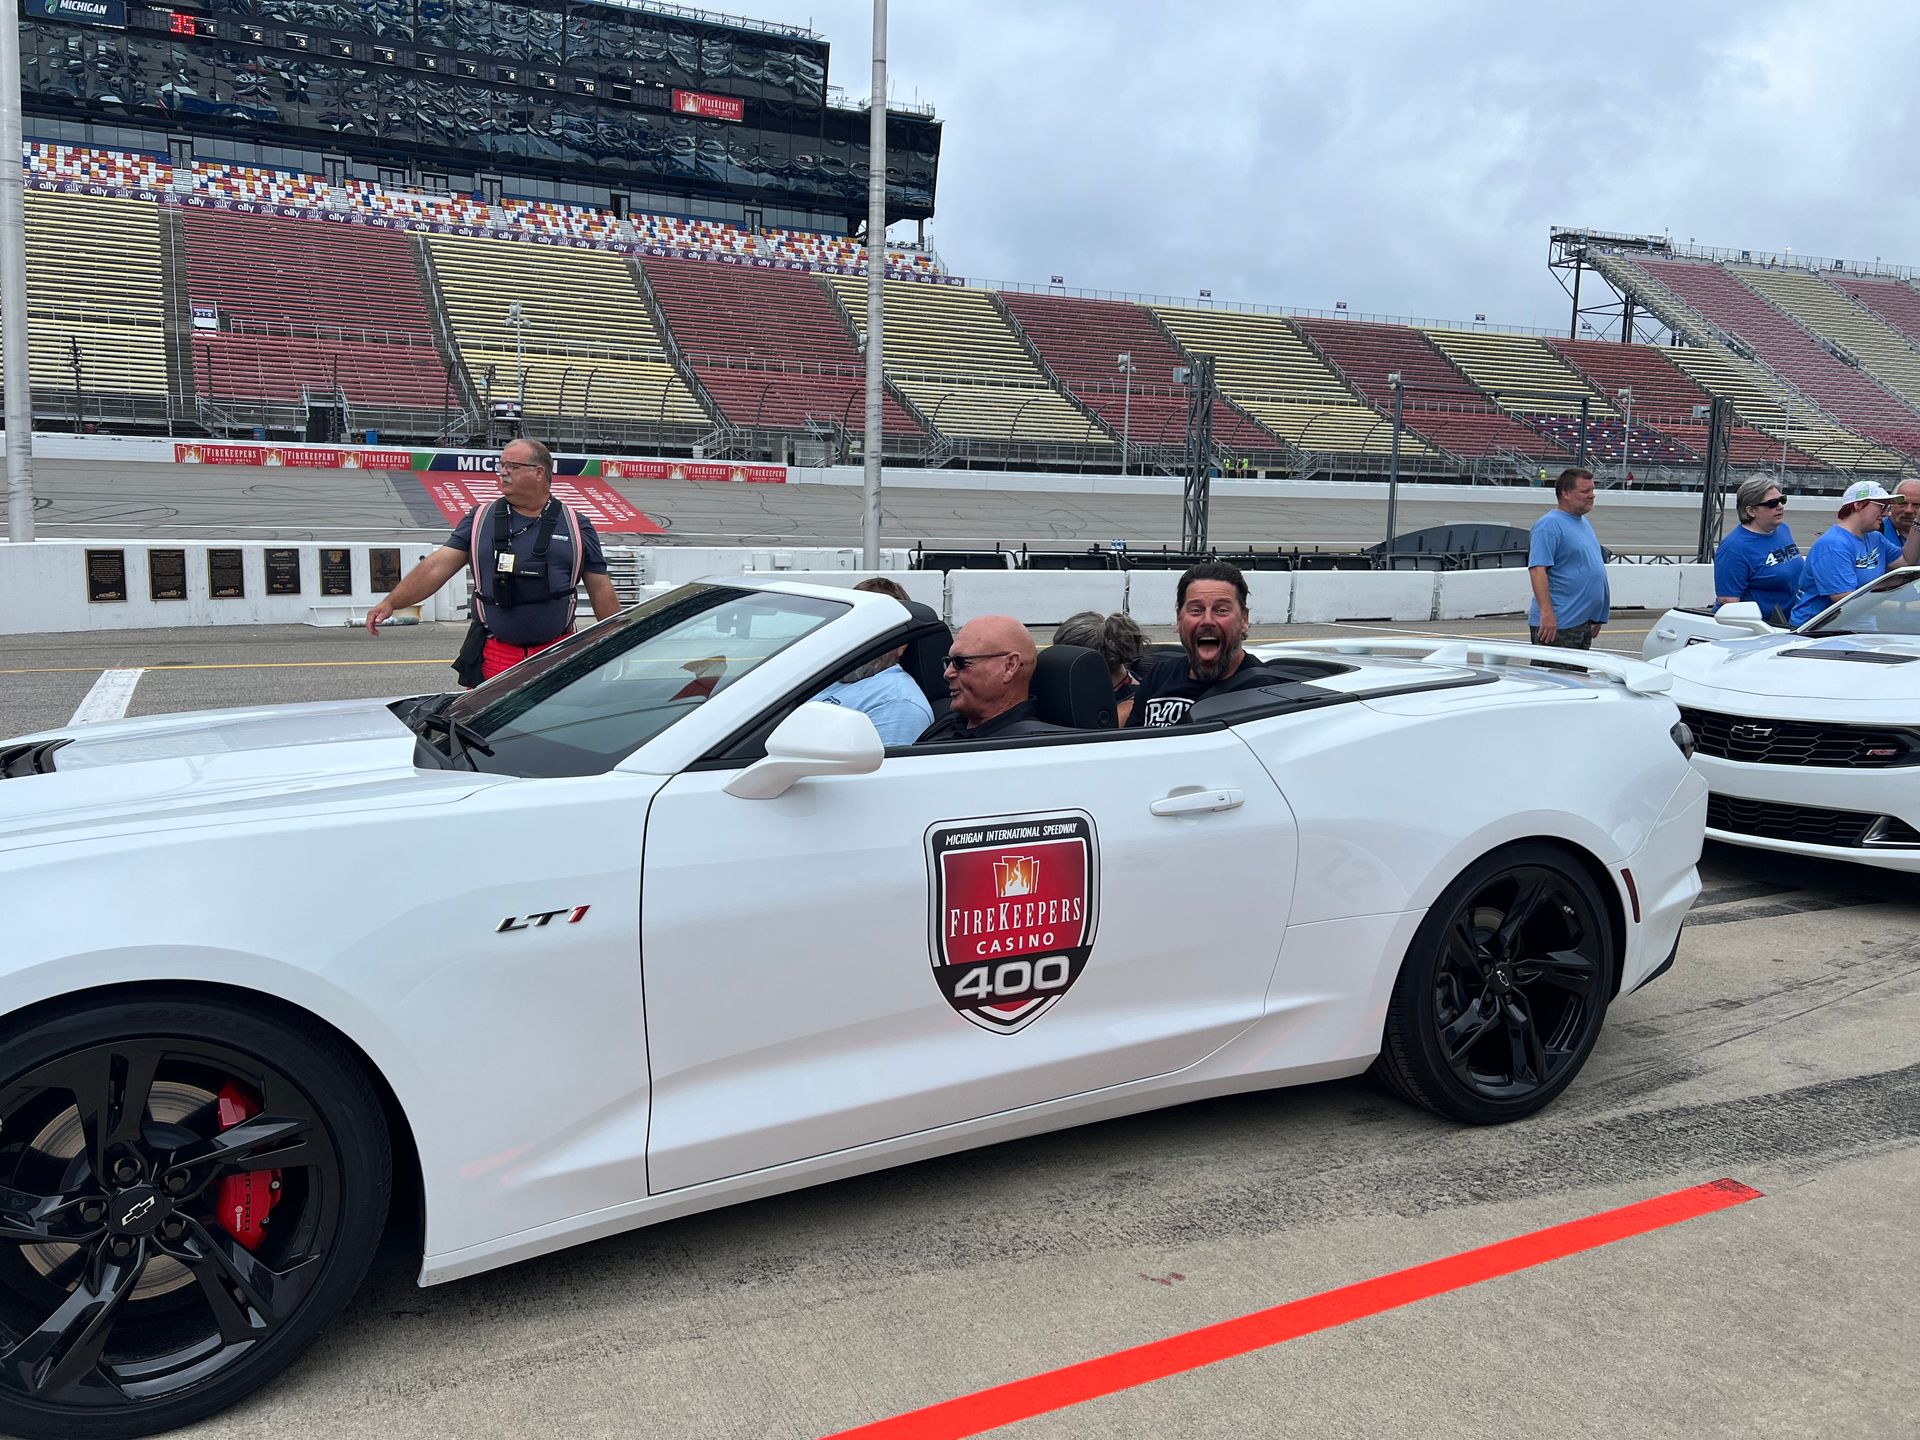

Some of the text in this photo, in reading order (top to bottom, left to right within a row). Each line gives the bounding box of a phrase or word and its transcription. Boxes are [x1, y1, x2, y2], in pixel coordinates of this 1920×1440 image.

[60, 0, 108, 15] MICHIGAN
[170, 13, 195, 35] 35
[208, 24, 214, 33] 1
[254, 31, 261, 40] 2
[299, 38, 306, 47] 3
[343, 46, 350, 54] 4
[386, 52, 393, 60] 5
[428, 59, 435, 67] 6
[469, 66, 476, 74] 7
[509, 72, 516, 80] 8
[548, 78, 555, 86] 9
[585, 83, 595, 92] 10
[39, 182, 58, 192] ally
[89, 186, 108, 197] ally
[139, 190, 157, 202] ally
[187, 197, 205, 208] ally
[237, 203, 255, 213] ally
[283, 208, 301, 218] ally
[328, 212, 345, 223] ally
[372, 217, 389, 228] ally
[414, 223, 431, 233] ally
[458, 227, 474, 237] ally
[498, 231, 514, 241] ally
[537, 235, 553, 245] ally
[576, 240, 590, 249] ally
[613, 243, 628, 252] ally
[652, 247, 666, 257] ally
[688, 251, 702, 261] ally
[206, 447, 257, 459] FIREKEEPERS
[287, 450, 335, 461] FIREKEEPERS
[945, 822, 1078, 846] MICHIGAN INTERNATIONAL SPEEDWAY
[495, 904, 591, 933] LT1
[976, 932, 1055, 955] CASINO
[954, 955, 1070, 1000] 400
